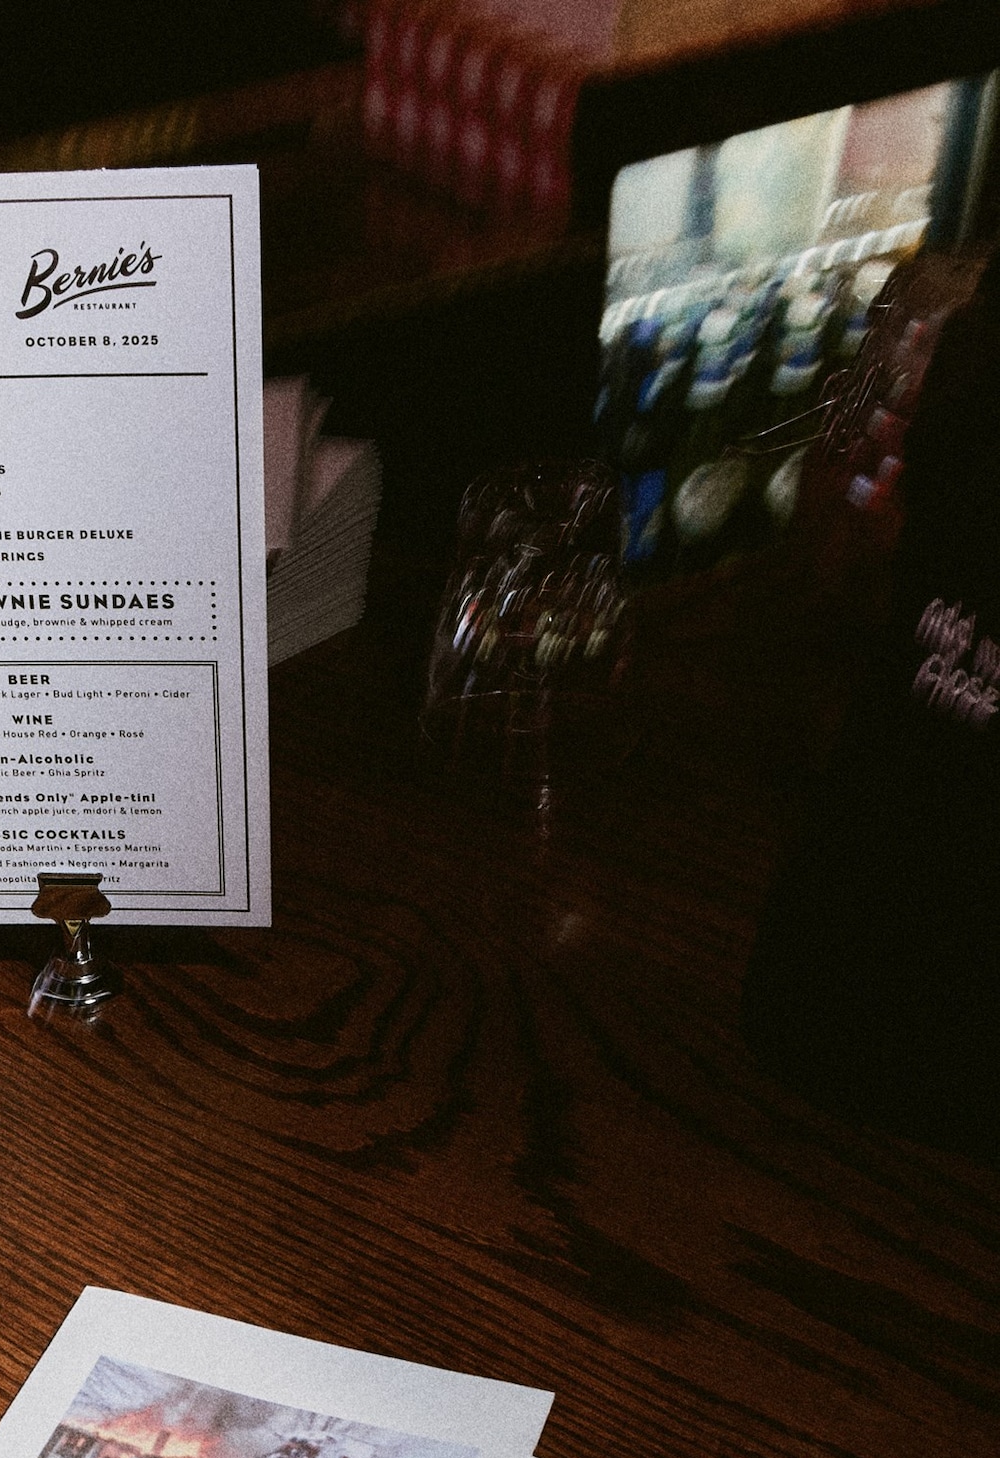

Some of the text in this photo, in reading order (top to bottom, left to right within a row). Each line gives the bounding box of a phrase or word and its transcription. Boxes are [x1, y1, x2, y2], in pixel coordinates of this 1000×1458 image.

[15, 241, 163, 320] Bernie's
[73, 302, 137, 311] RESTAURANT
[25, 334, 159, 348] OCTOBER 8, 2025
[16, 529, 75, 541] BURGER
[79, 529, 134, 540] DELUXE
[0, 551, 45, 562] RINGS
[59, 593, 175, 610] SUNDAES
[32, 618, 77, 627] brownie
[79, 617, 87, 627] &
[90, 617, 136, 628] whipped
[138, 618, 173, 627] cream
[7, 674, 51, 686] BEER
[10, 690, 41, 701] Lager
[52, 689, 74, 699] Bud
[76, 689, 104, 701] Light
[114, 689, 151, 699] Peroni
[162, 689, 190, 699] Cider
[11, 714, 53, 726] WINE
[2, 730, 36, 739] House
[37, 729, 58, 739] Red
[69, 729, 108, 740] Orange
[11, 768, 36, 777] Beer
[47, 768, 72, 777] Ghia
[73, 768, 106, 779] Spritz
[80, 792, 156, 805] Apple-tini
[21, 806, 50, 817] apple
[82, 807, 117, 816] midori
[119, 806, 127, 815] &
[129, 806, 163, 816] lemon
[34, 829, 126, 840] COCKTAILS
[26, 844, 64, 852] Martini
[73, 843, 122, 854] Espresso
[124, 843, 162, 853] Martini
[5, 859, 57, 868] Fashioned
[67, 859, 109, 869] Negroni
[118, 859, 170, 870] Margarita
